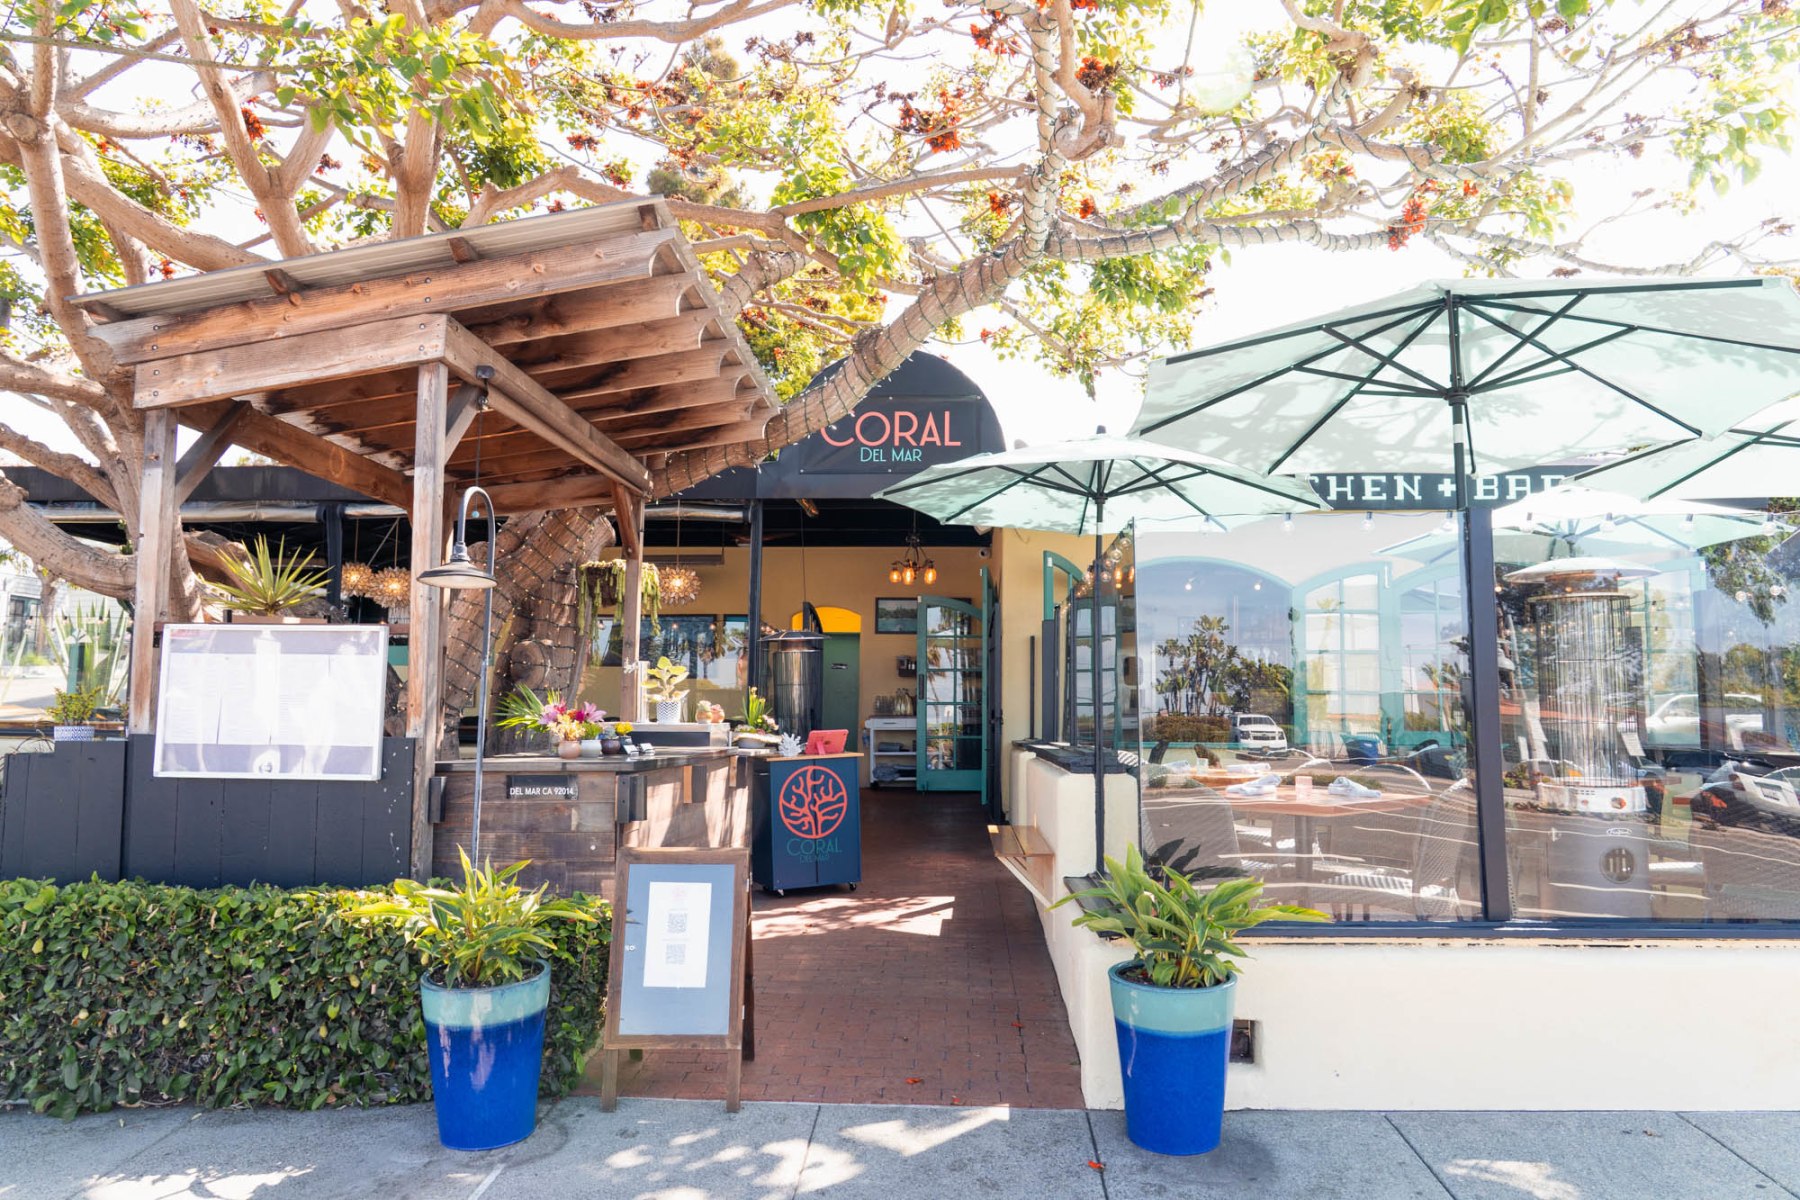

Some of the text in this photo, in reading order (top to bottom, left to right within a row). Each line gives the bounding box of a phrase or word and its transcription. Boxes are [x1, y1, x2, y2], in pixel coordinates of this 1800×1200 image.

[820, 410, 961, 447] CORAL
[860, 446, 922, 462] DEL MAR
[509, 786, 574, 796] DEL MAR CA 92014
[786, 837, 842, 856] CORAL
